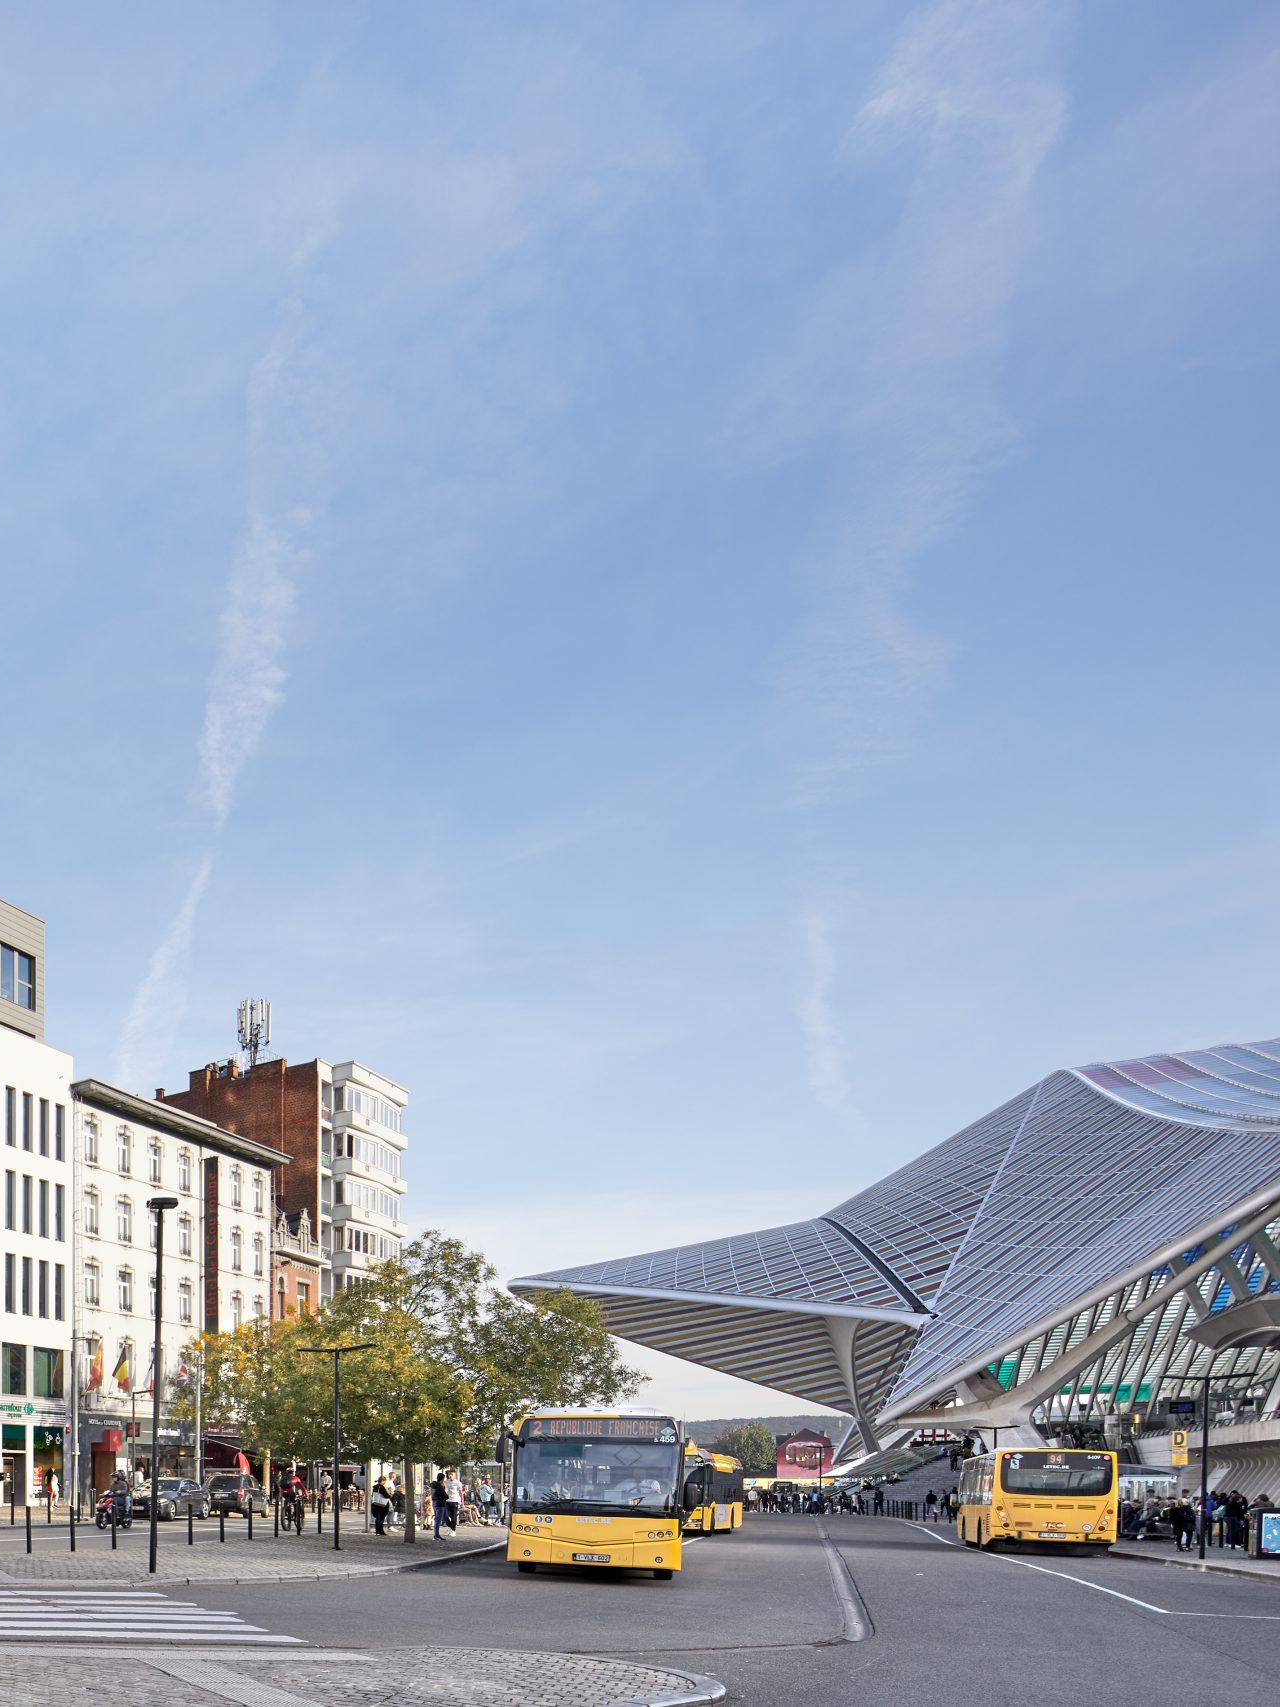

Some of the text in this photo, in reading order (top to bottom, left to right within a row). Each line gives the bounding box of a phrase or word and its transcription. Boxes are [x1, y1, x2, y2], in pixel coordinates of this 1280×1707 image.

[532, 1421, 542, 1435] 2
[549, 1420, 603, 1435] REPUBLIQUE
[1173, 1431, 1185, 1446] D
[1049, 1454, 1062, 1464] 94
